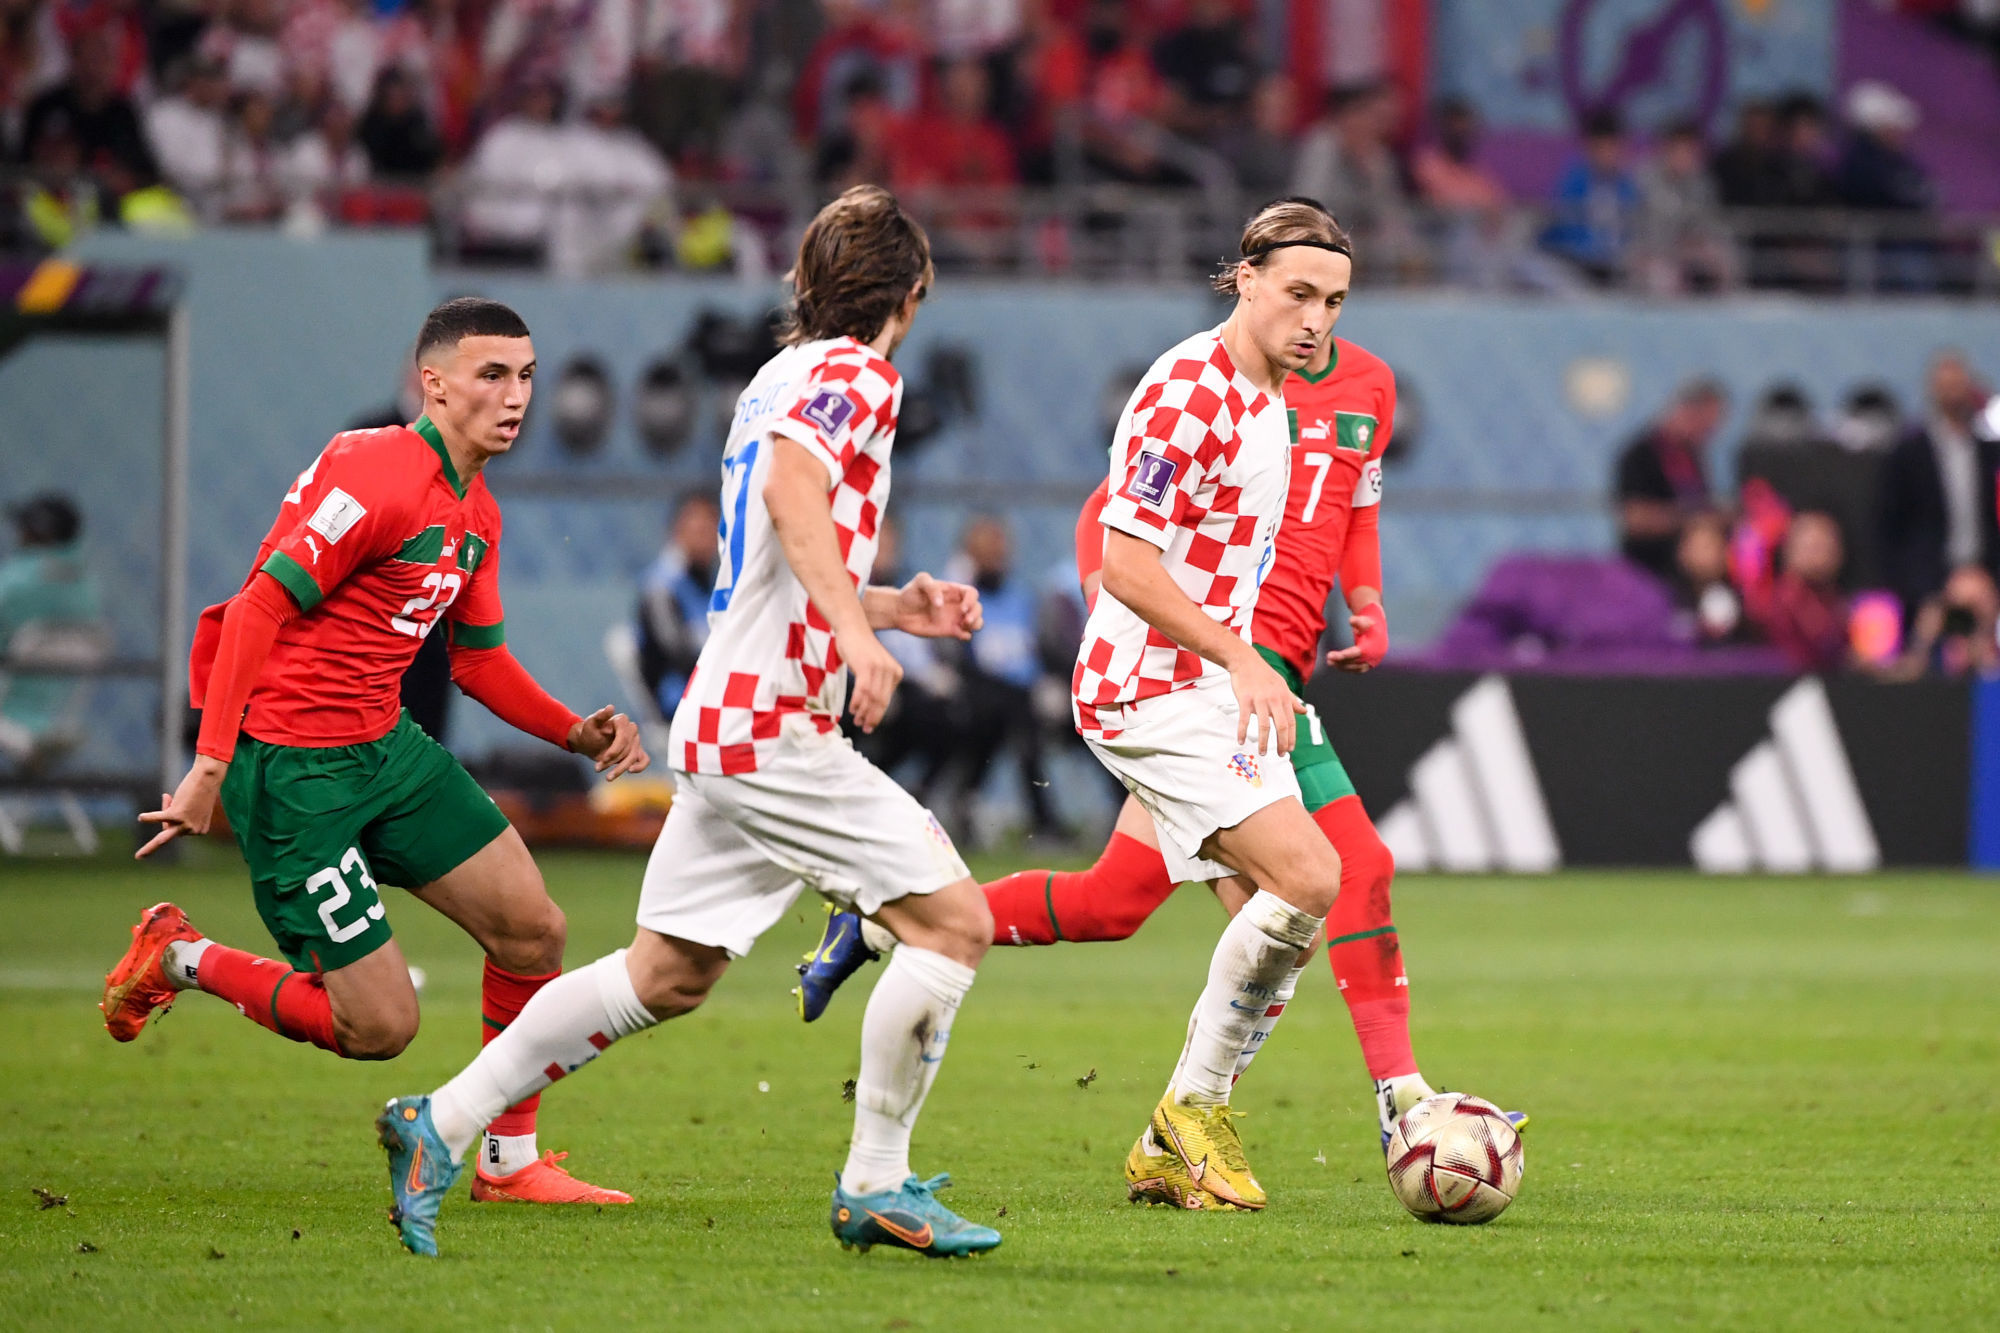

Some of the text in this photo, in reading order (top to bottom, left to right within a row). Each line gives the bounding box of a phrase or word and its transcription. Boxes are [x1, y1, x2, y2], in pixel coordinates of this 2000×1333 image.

[1301, 451, 1334, 523] 7
[391, 572, 462, 639] 23
[305, 846, 386, 944] 23
